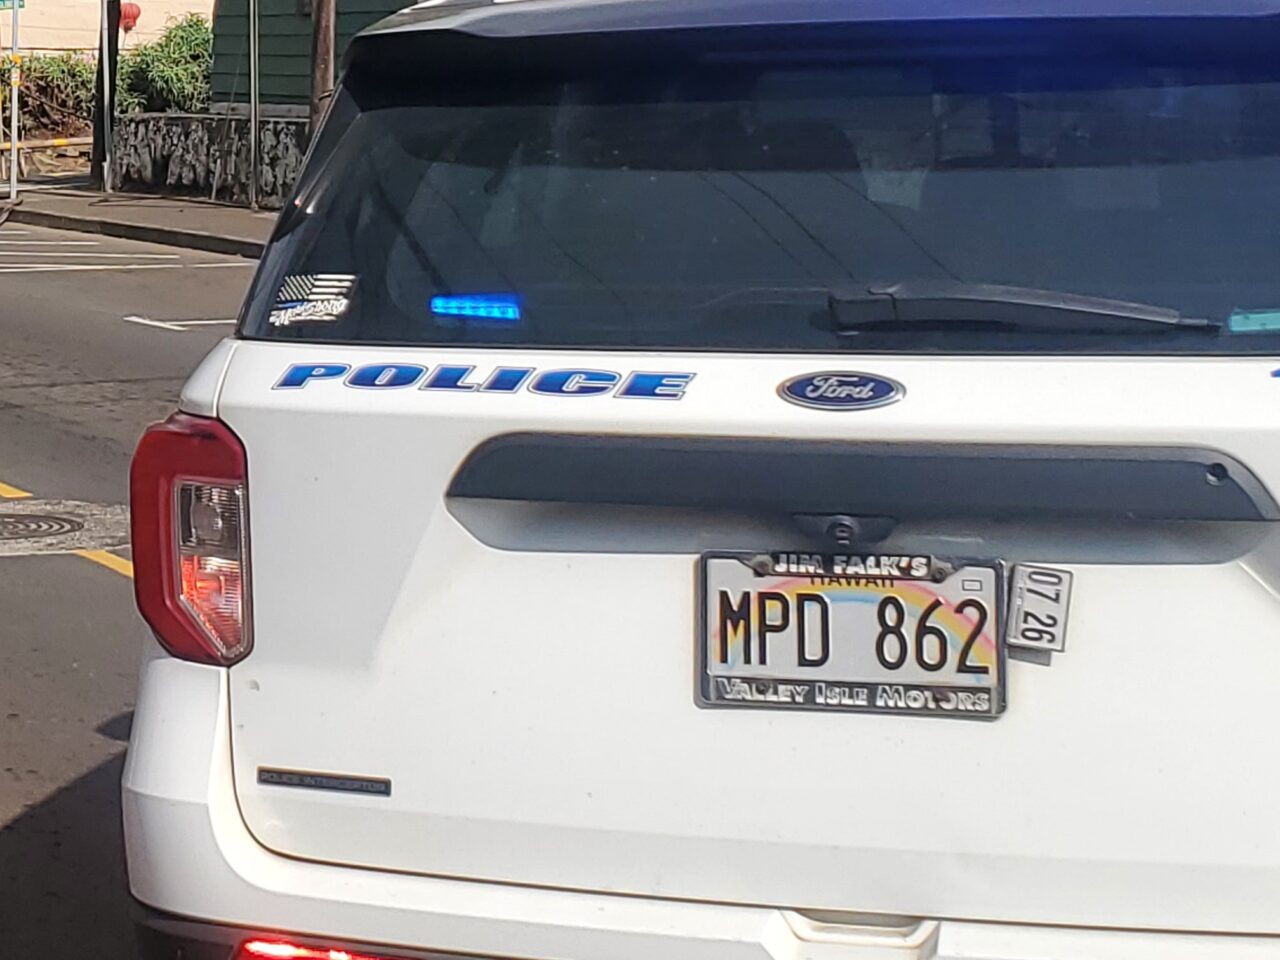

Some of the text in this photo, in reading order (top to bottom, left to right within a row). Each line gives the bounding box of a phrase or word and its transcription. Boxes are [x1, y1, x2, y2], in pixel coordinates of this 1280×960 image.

[270, 363, 697, 400] POLICE
[805, 375, 875, 399] Ford
[774, 553, 928, 578] JIM FALK'S
[720, 589, 990, 675] MPD 862
[718, 678, 808, 703] VALLEY
[815, 683, 868, 707] ISLE
